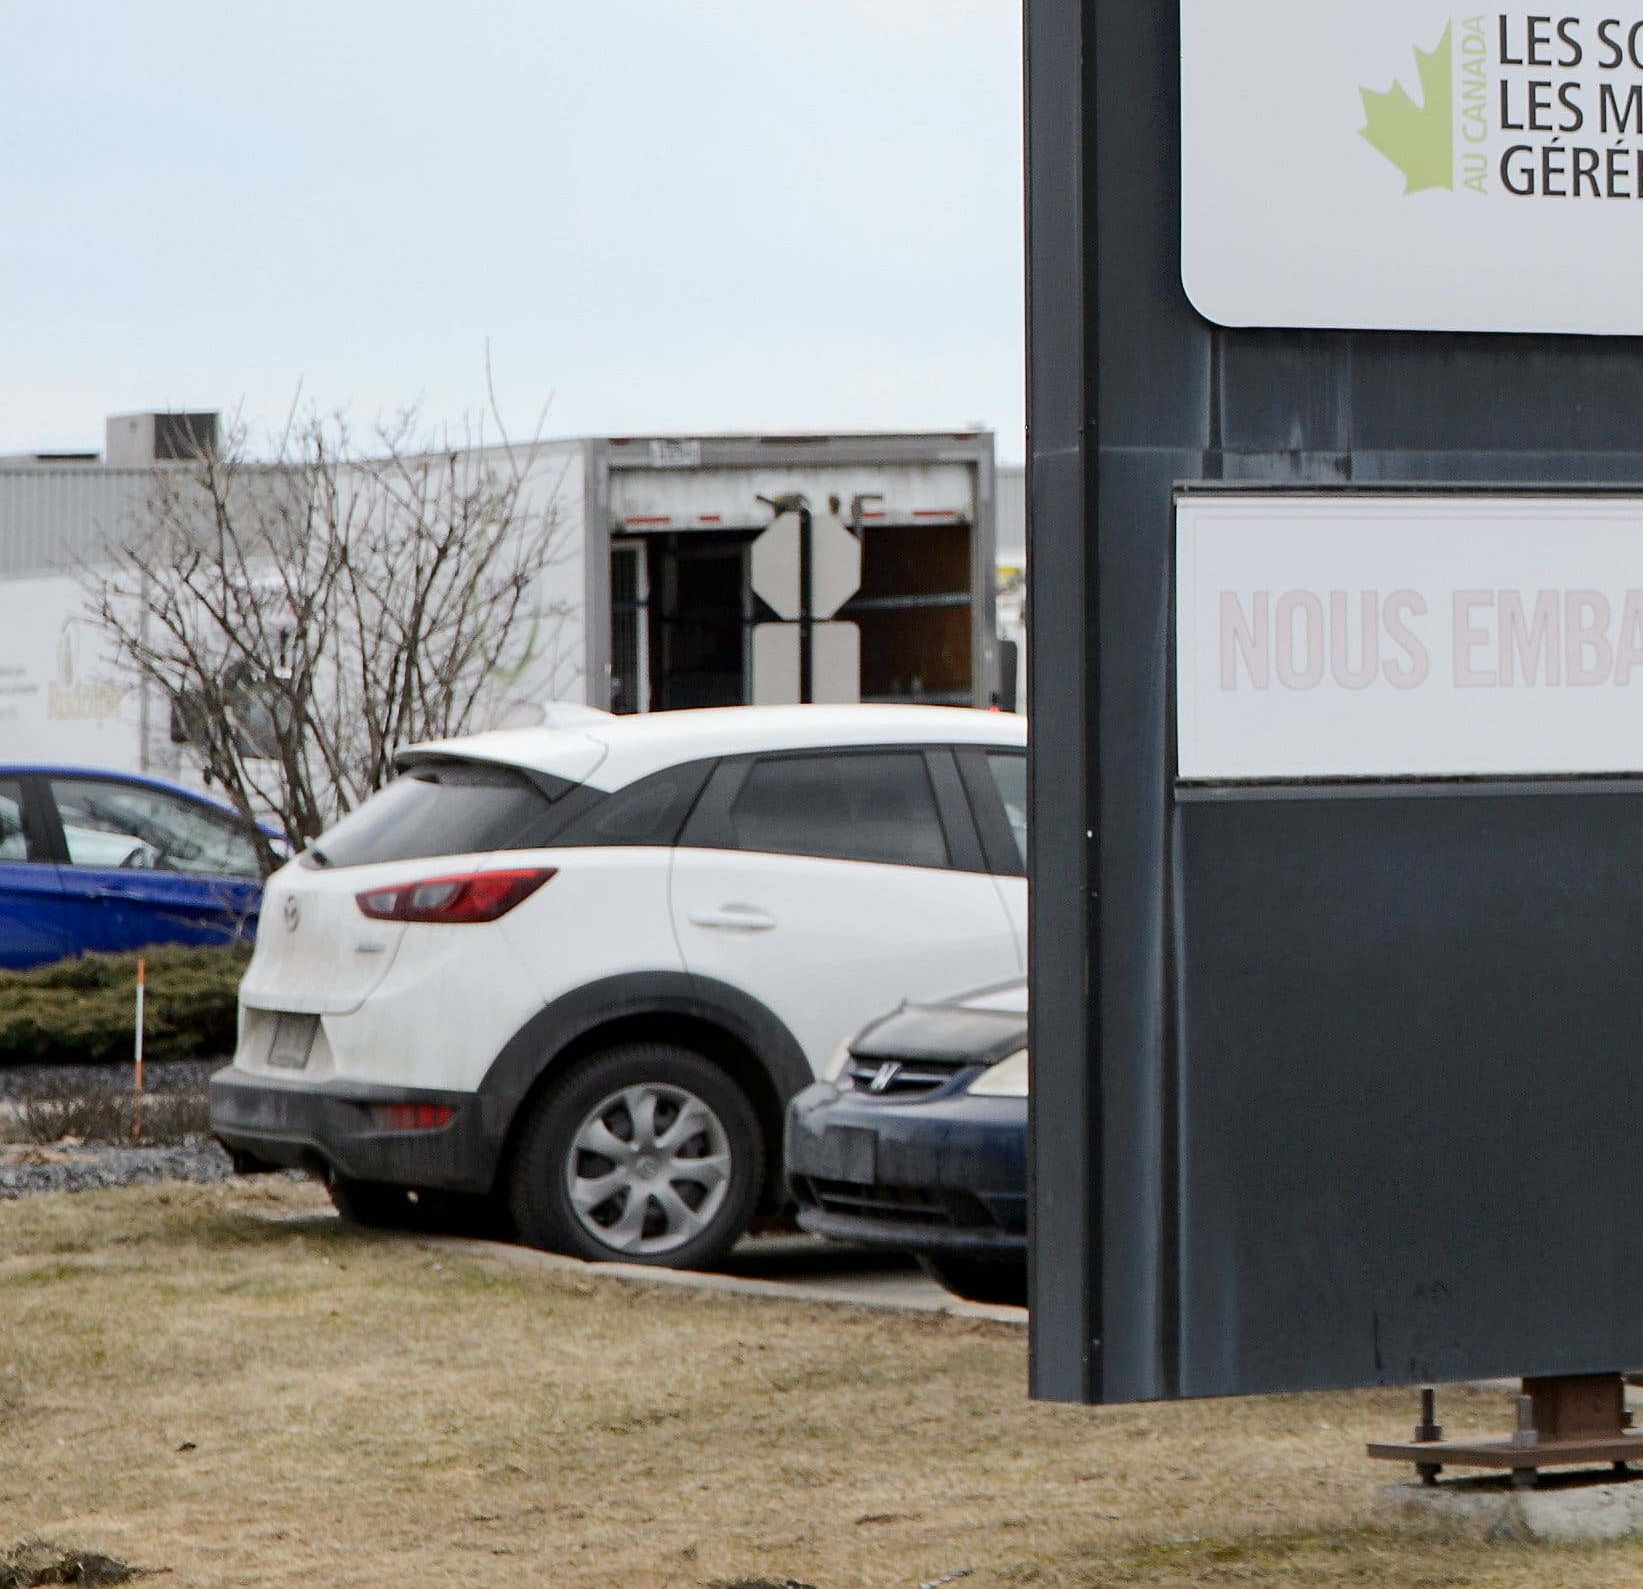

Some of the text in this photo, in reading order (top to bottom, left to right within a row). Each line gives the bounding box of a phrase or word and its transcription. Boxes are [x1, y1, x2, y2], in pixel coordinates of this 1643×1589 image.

[1500, 14, 1583, 68] LES
[1461, 14, 1488, 195] AU CANADA
[1500, 79, 1584, 133] LES
[1219, 588, 1429, 691] NOUS
